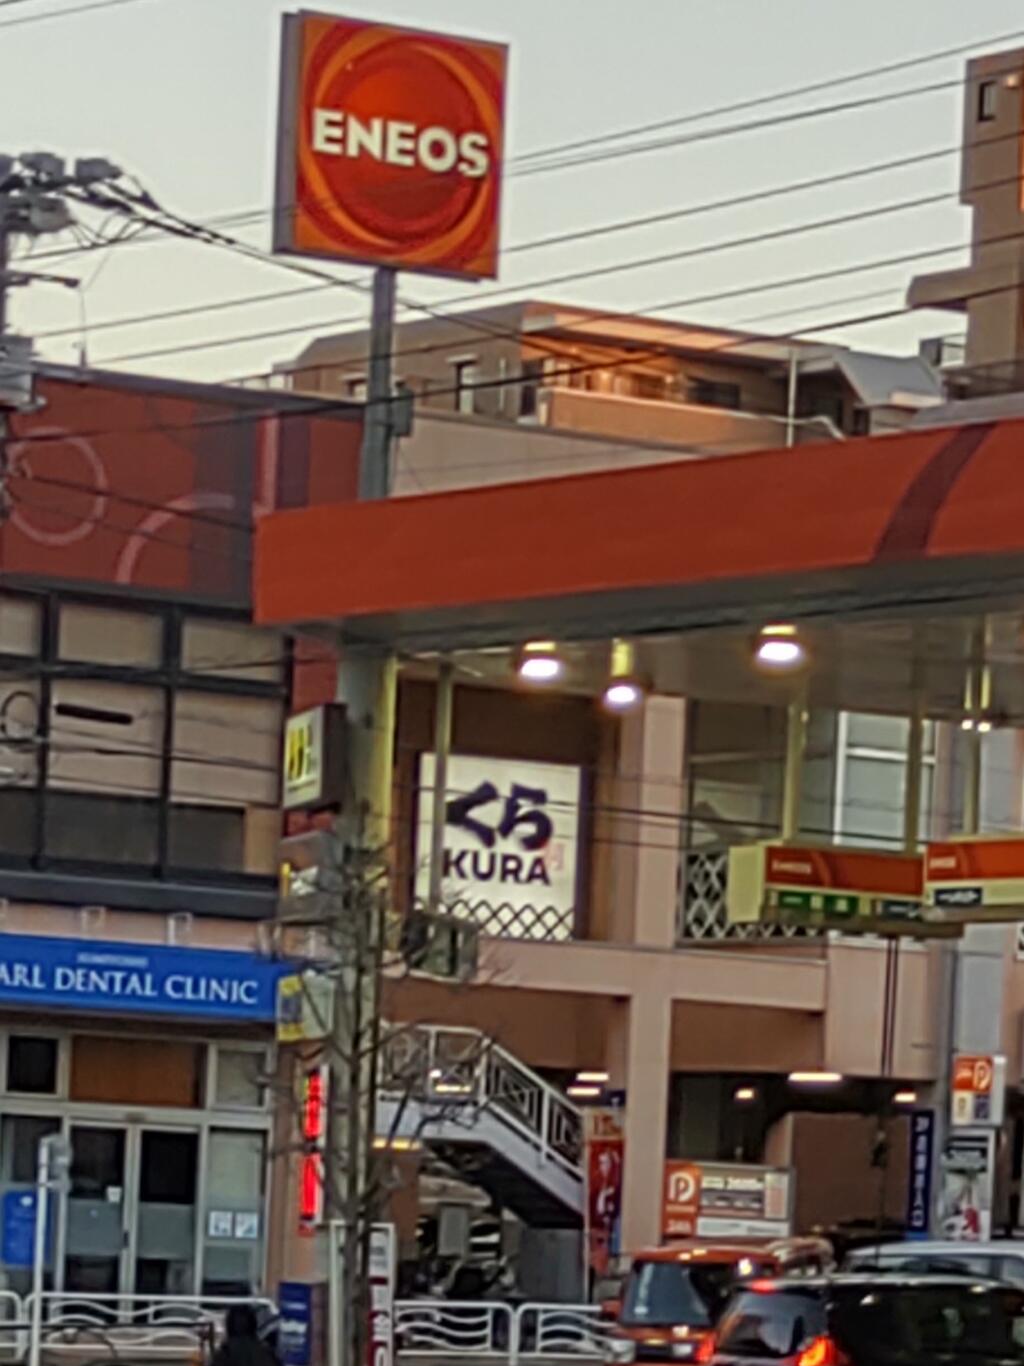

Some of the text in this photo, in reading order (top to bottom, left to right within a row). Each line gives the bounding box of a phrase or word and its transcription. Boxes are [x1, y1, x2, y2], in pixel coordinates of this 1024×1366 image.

[312, 107, 490, 178] ENEOS
[445, 780, 553, 851] くら
[442, 849, 551, 887] KURA
[54, 966, 158, 997] DENTAL
[164, 974, 259, 1004] CLINIC
